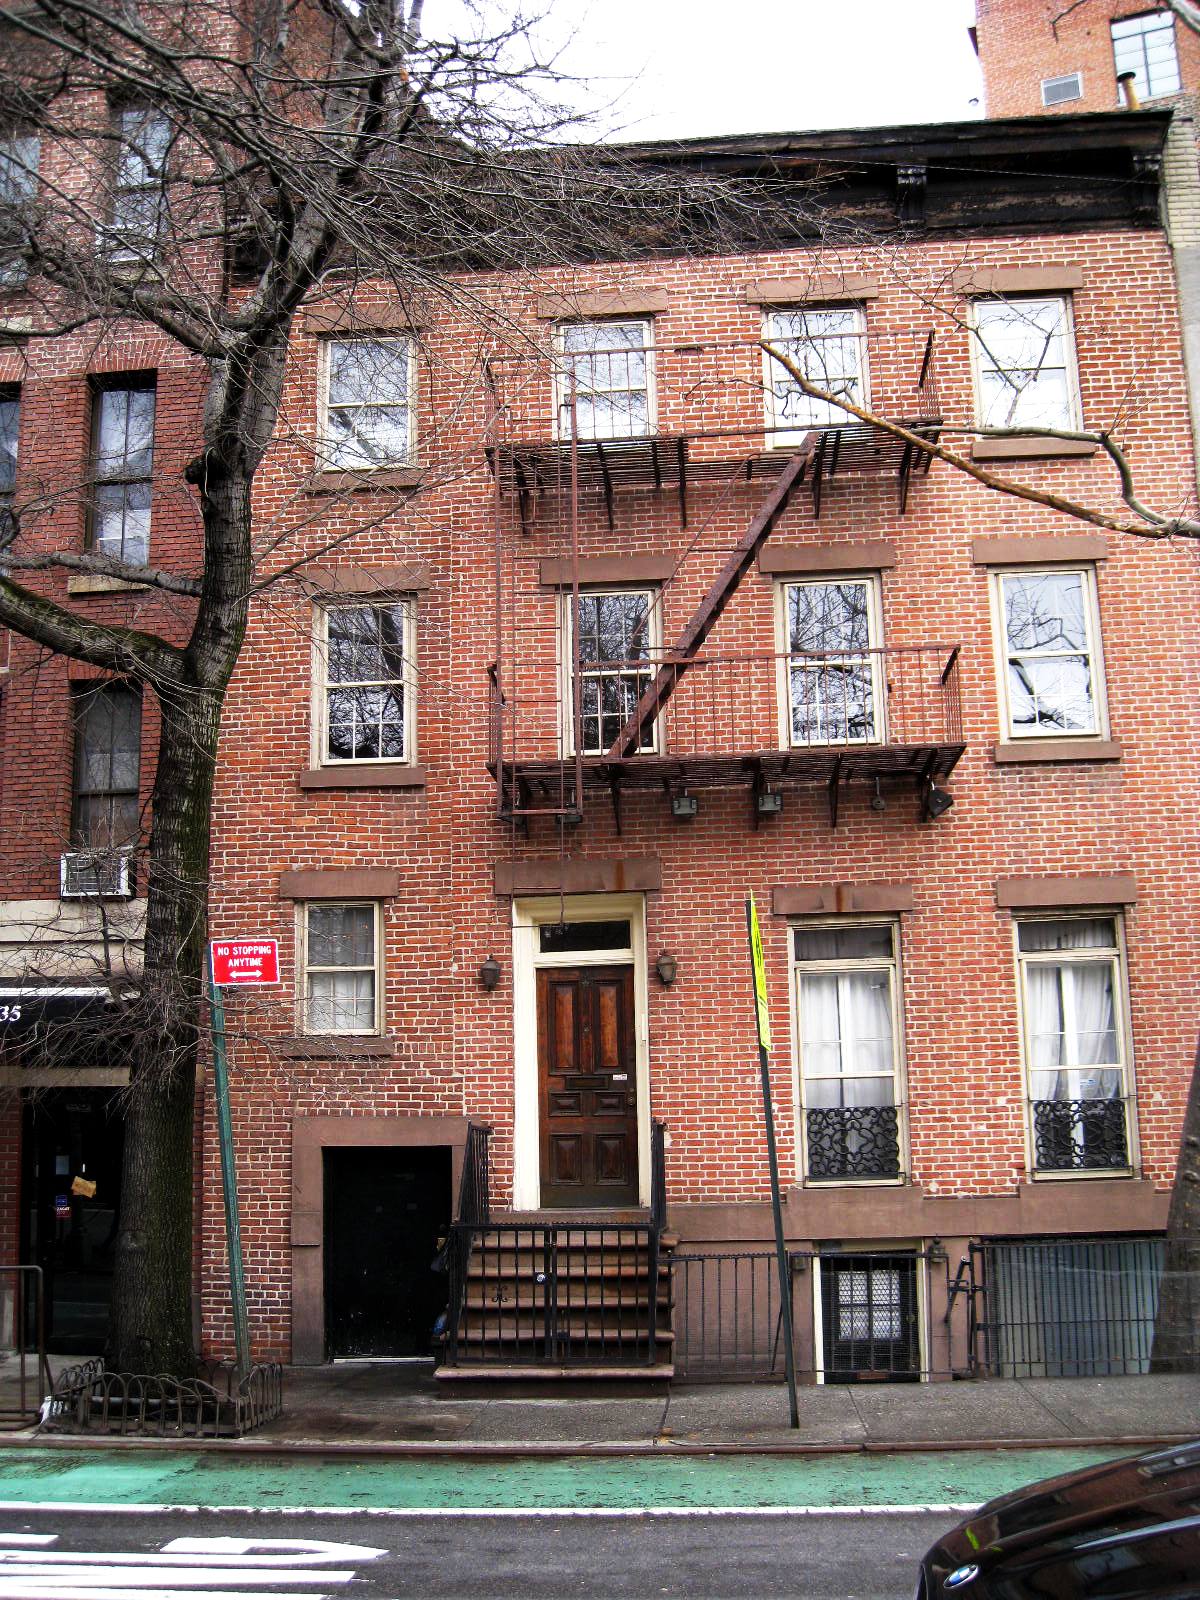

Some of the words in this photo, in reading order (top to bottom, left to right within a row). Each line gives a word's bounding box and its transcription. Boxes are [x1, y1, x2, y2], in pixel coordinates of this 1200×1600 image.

[217, 947, 229, 955] NO
[232, 945, 272, 955] STOPPING
[228, 957, 263, 967] ANYTIME
[0, 1005, 21, 1021] 35
